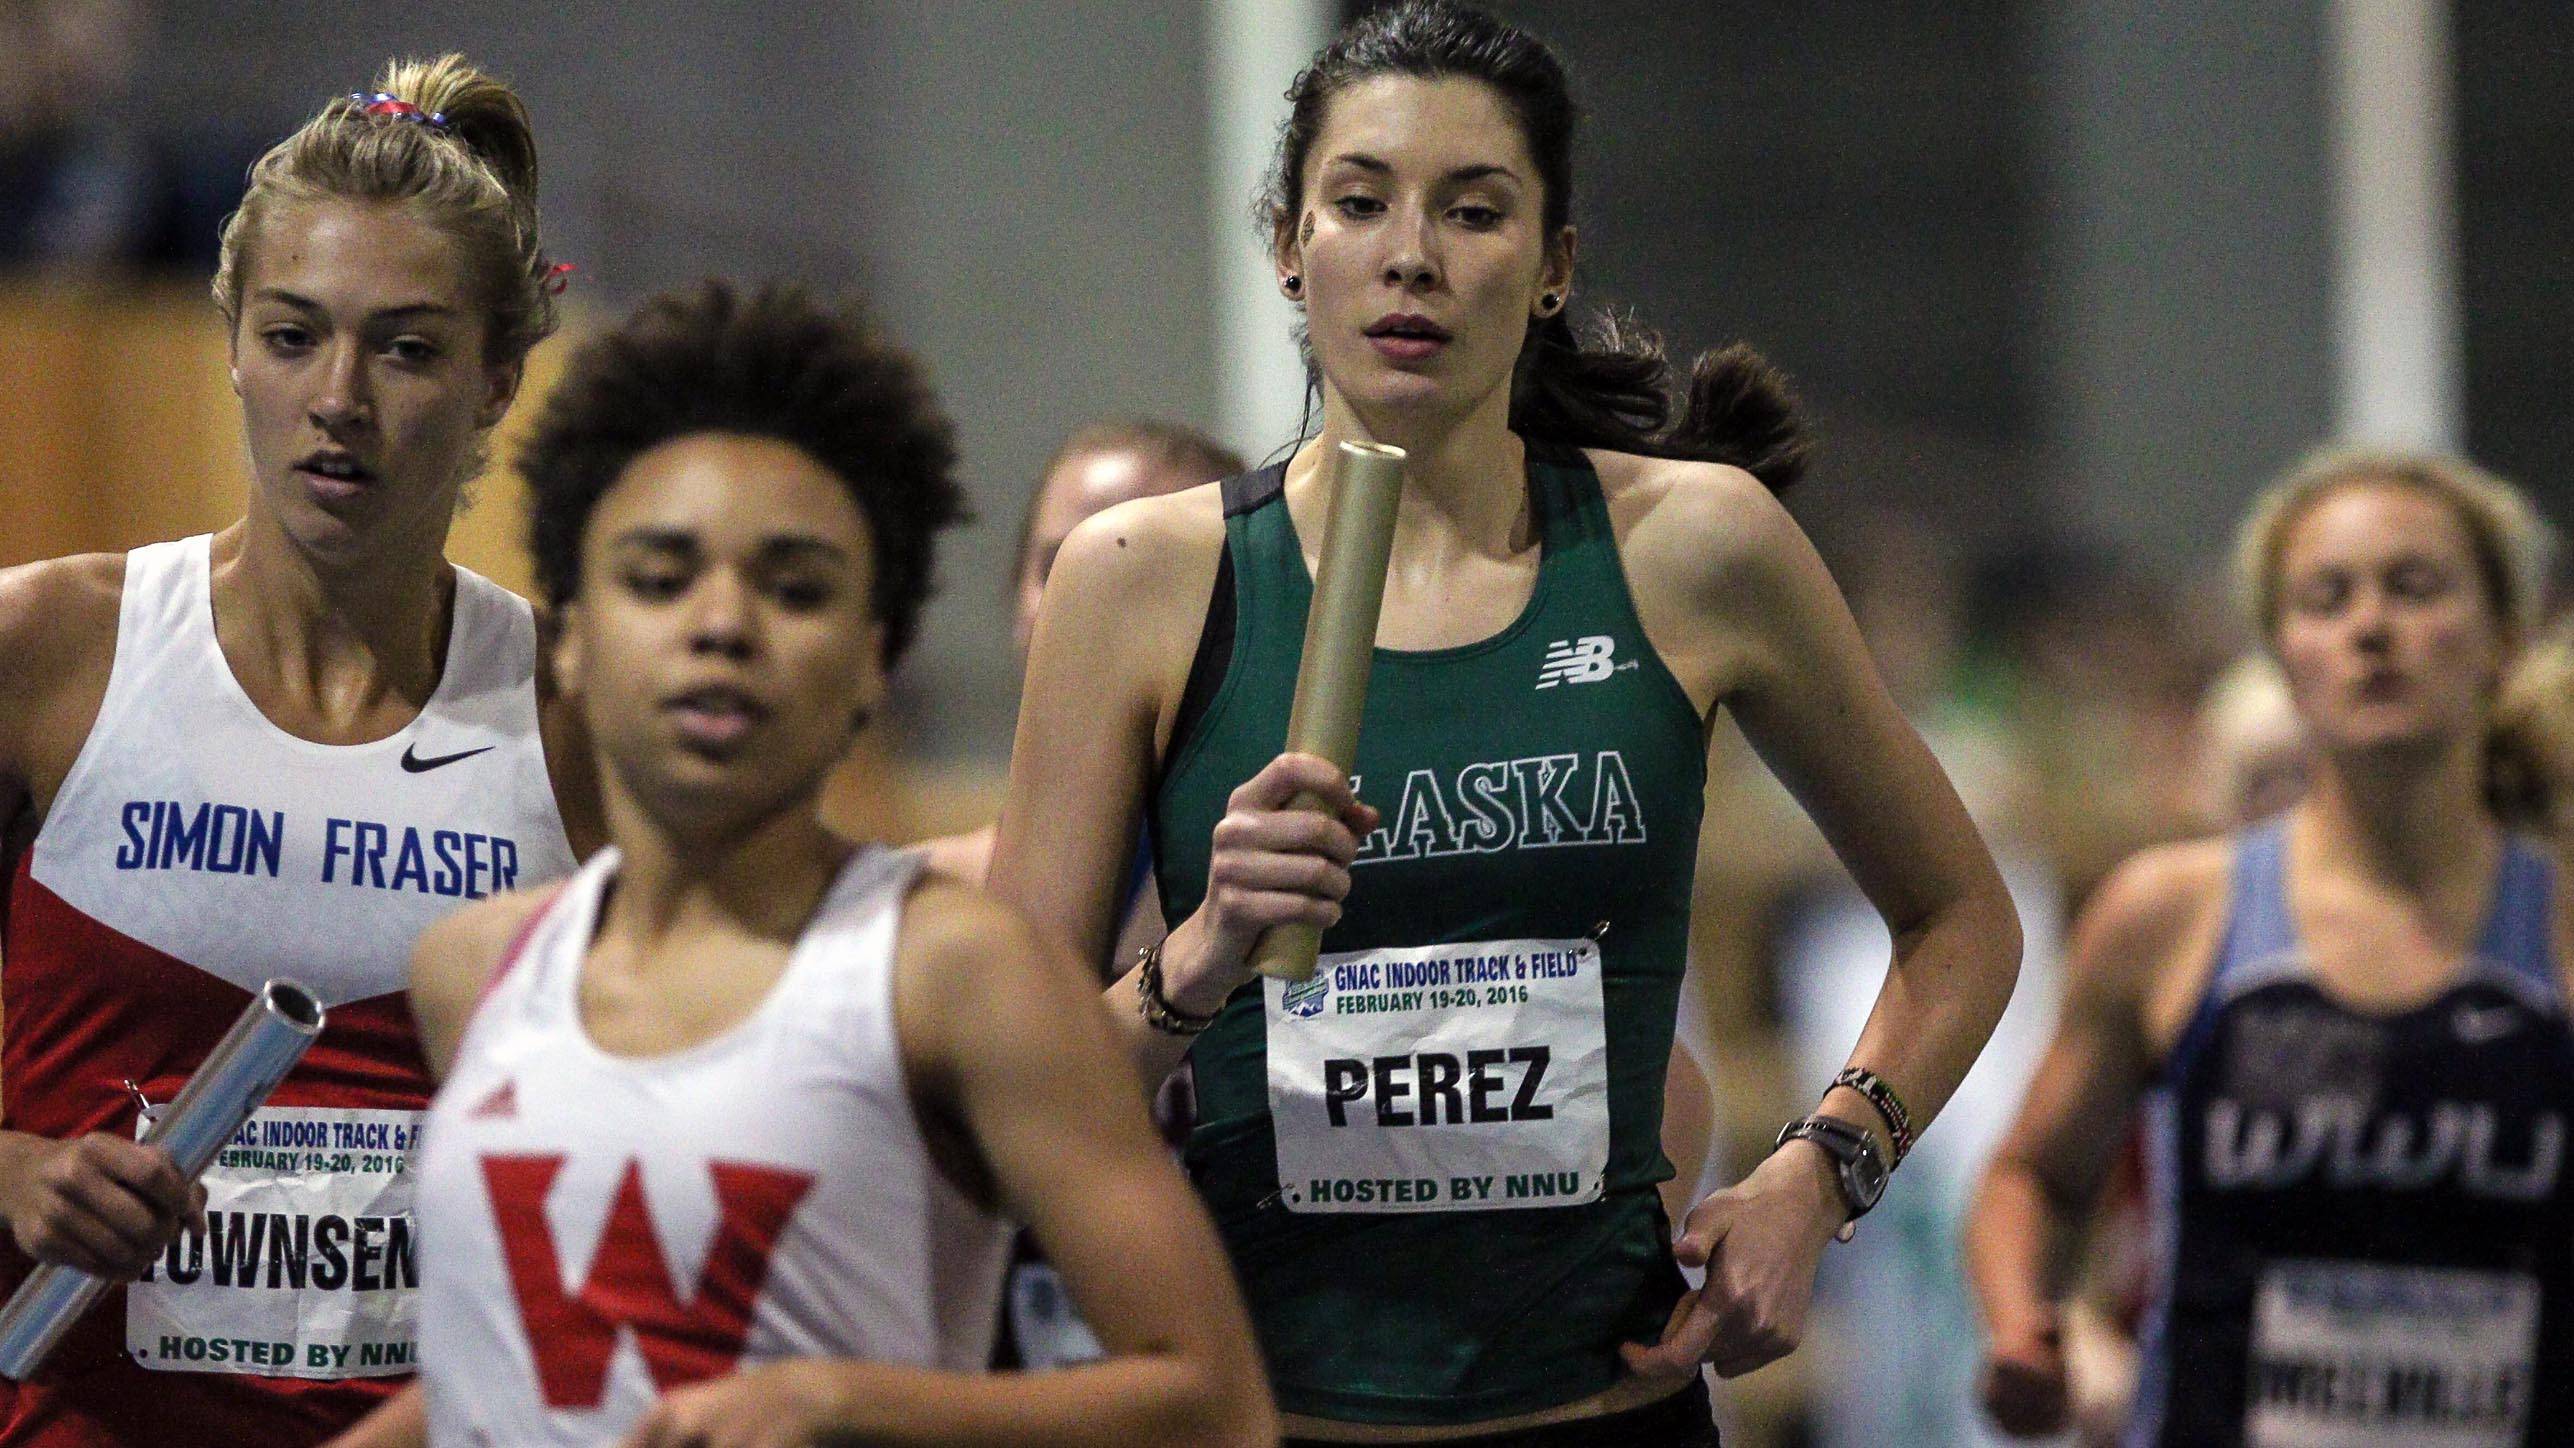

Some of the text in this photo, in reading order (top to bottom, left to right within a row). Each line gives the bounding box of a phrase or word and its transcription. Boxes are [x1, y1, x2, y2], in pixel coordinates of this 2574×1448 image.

[1347, 750, 1647, 866] ASKA
[115, 800, 519, 901] SIMON FRASER
[1335, 952, 1578, 991] GNAC INDOOR TRACK & FIELD
[1336, 984, 1529, 1015] FEBRUARY 19-20, 2016
[1324, 1045, 1554, 1128] PEREZ
[263, 1119, 328, 1148] INDOOR
[333, 1121, 390, 1150] TRACK
[394, 1126, 406, 1150] &
[219, 1150, 405, 1174] EBRUARY 19-20, 2016
[1310, 1171, 1580, 1204] HOSTED BY NNU
[139, 1210, 420, 1292] OWNSEN
[477, 1151, 818, 1407] W
[159, 1335, 295, 1366] HOSTED
[306, 1342, 350, 1368] BY
